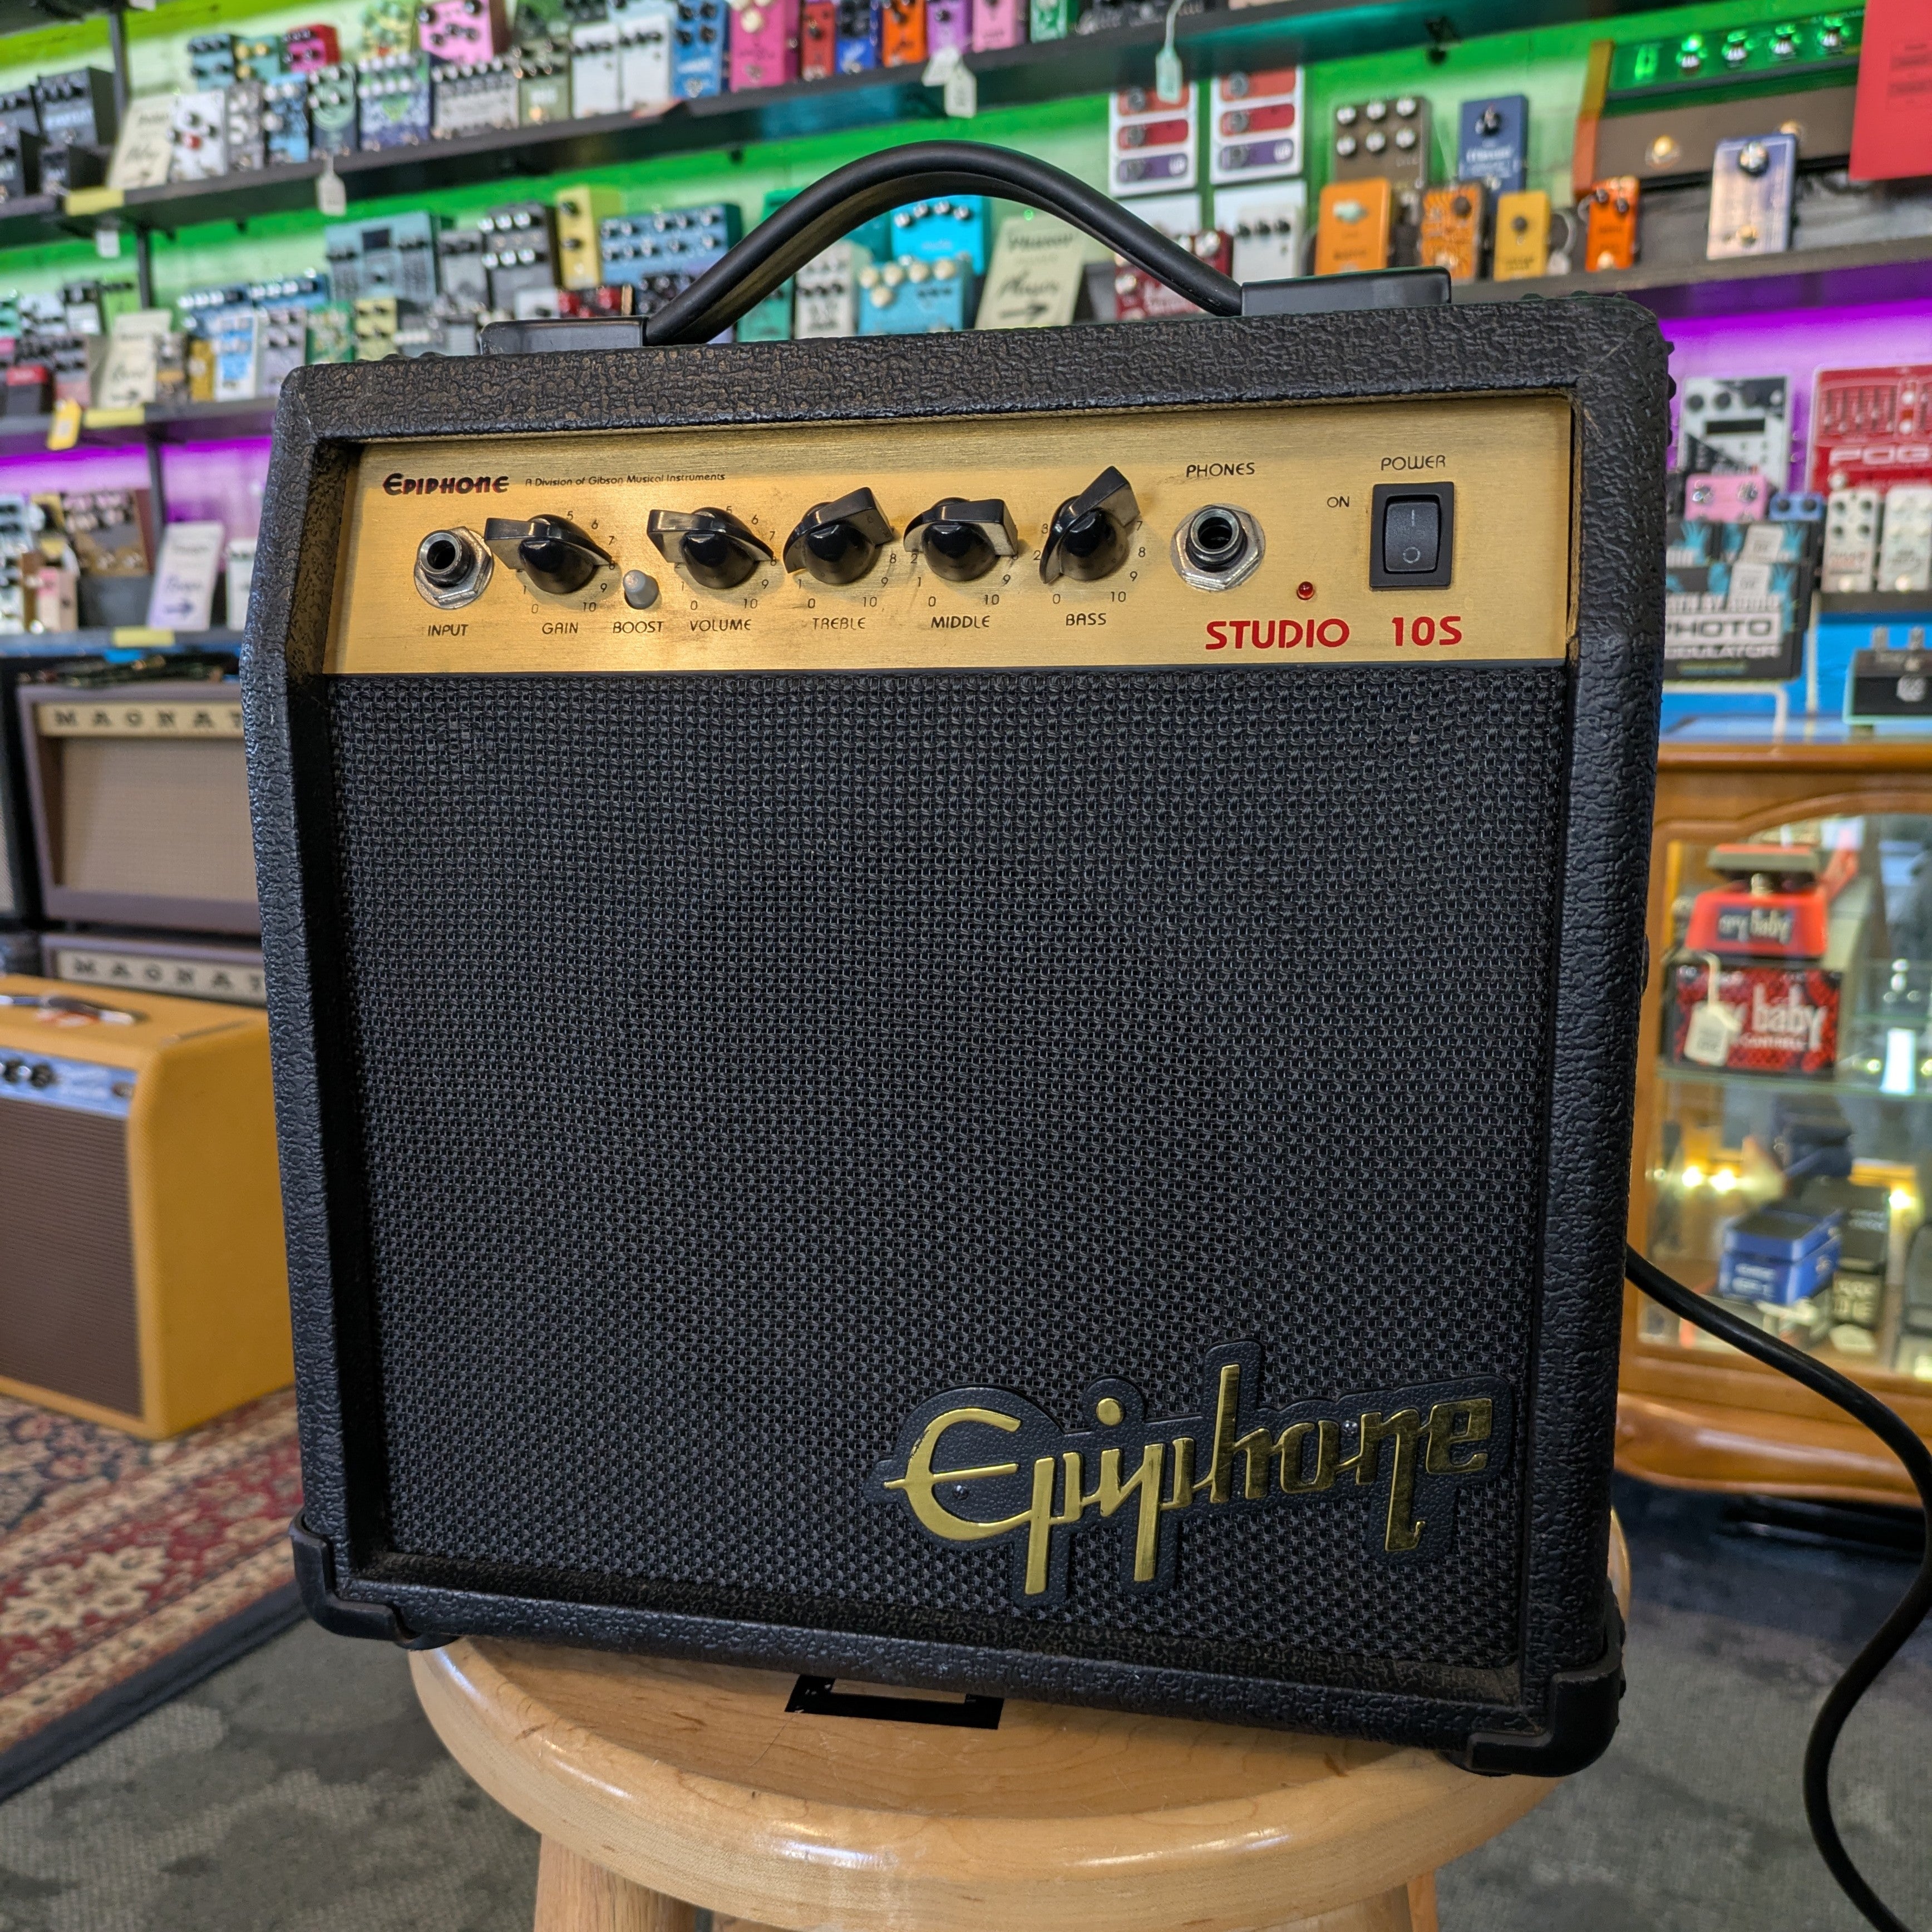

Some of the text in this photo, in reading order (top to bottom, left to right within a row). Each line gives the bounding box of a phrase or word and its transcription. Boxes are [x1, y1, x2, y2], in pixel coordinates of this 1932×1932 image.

[1381, 455, 1446, 471] POWER
[1186, 462, 1255, 477] PHONES
[525, 473, 726, 487] A Division of Gibson Musical Instruments
[1327, 496, 1350, 508] ON
[567, 510, 574, 521] 5
[752, 514, 759, 525] 6
[592, 519, 599, 530] 6
[1042, 523, 1048, 534] 3
[1136, 521, 1143, 531] 7
[609, 535, 615, 545] 7
[770, 531, 776, 541] 7
[1033, 550, 1041, 560] 2
[1138, 546, 1146, 558] 8
[770, 556, 777, 566] 8
[890, 553, 896, 564] 8
[910, 553, 918, 564] 2
[609, 560, 615, 570] 8
[881, 576, 889, 587] 9
[918, 576, 921, 587] 1
[1003, 574, 1011, 585] 9
[1130, 571, 1138, 581] 9
[600, 583, 608, 593] 9
[682, 581, 684, 591] 1
[762, 579, 769, 590] 9
[798, 579, 802, 589] 1
[523, 585, 526, 595] 1
[862, 597, 878, 607] 10
[928, 596, 937, 607] 0
[984, 594, 999, 605] 10
[1053, 593, 1061, 604] 0
[1111, 591, 1127, 603] 10
[531, 603, 539, 614] 0
[583, 602, 597, 612] 10
[691, 600, 698, 610] 0
[743, 598, 758, 609] 10
[808, 598, 816, 609] 0
[812, 617, 866, 630] TREBLE
[931, 615, 990, 629] MIDDLE
[1066, 613, 1107, 626] BASS
[428, 624, 469, 637] INPUT
[542, 622, 579, 634] GAIN
[612, 621, 663, 634] BOOST
[690, 619, 752, 632] VOLUME
[1205, 615, 1462, 650] STUDIO 10S
[1752, 982, 1827, 1052] baby
[884, 1363, 1495, 1595] Epiphone
